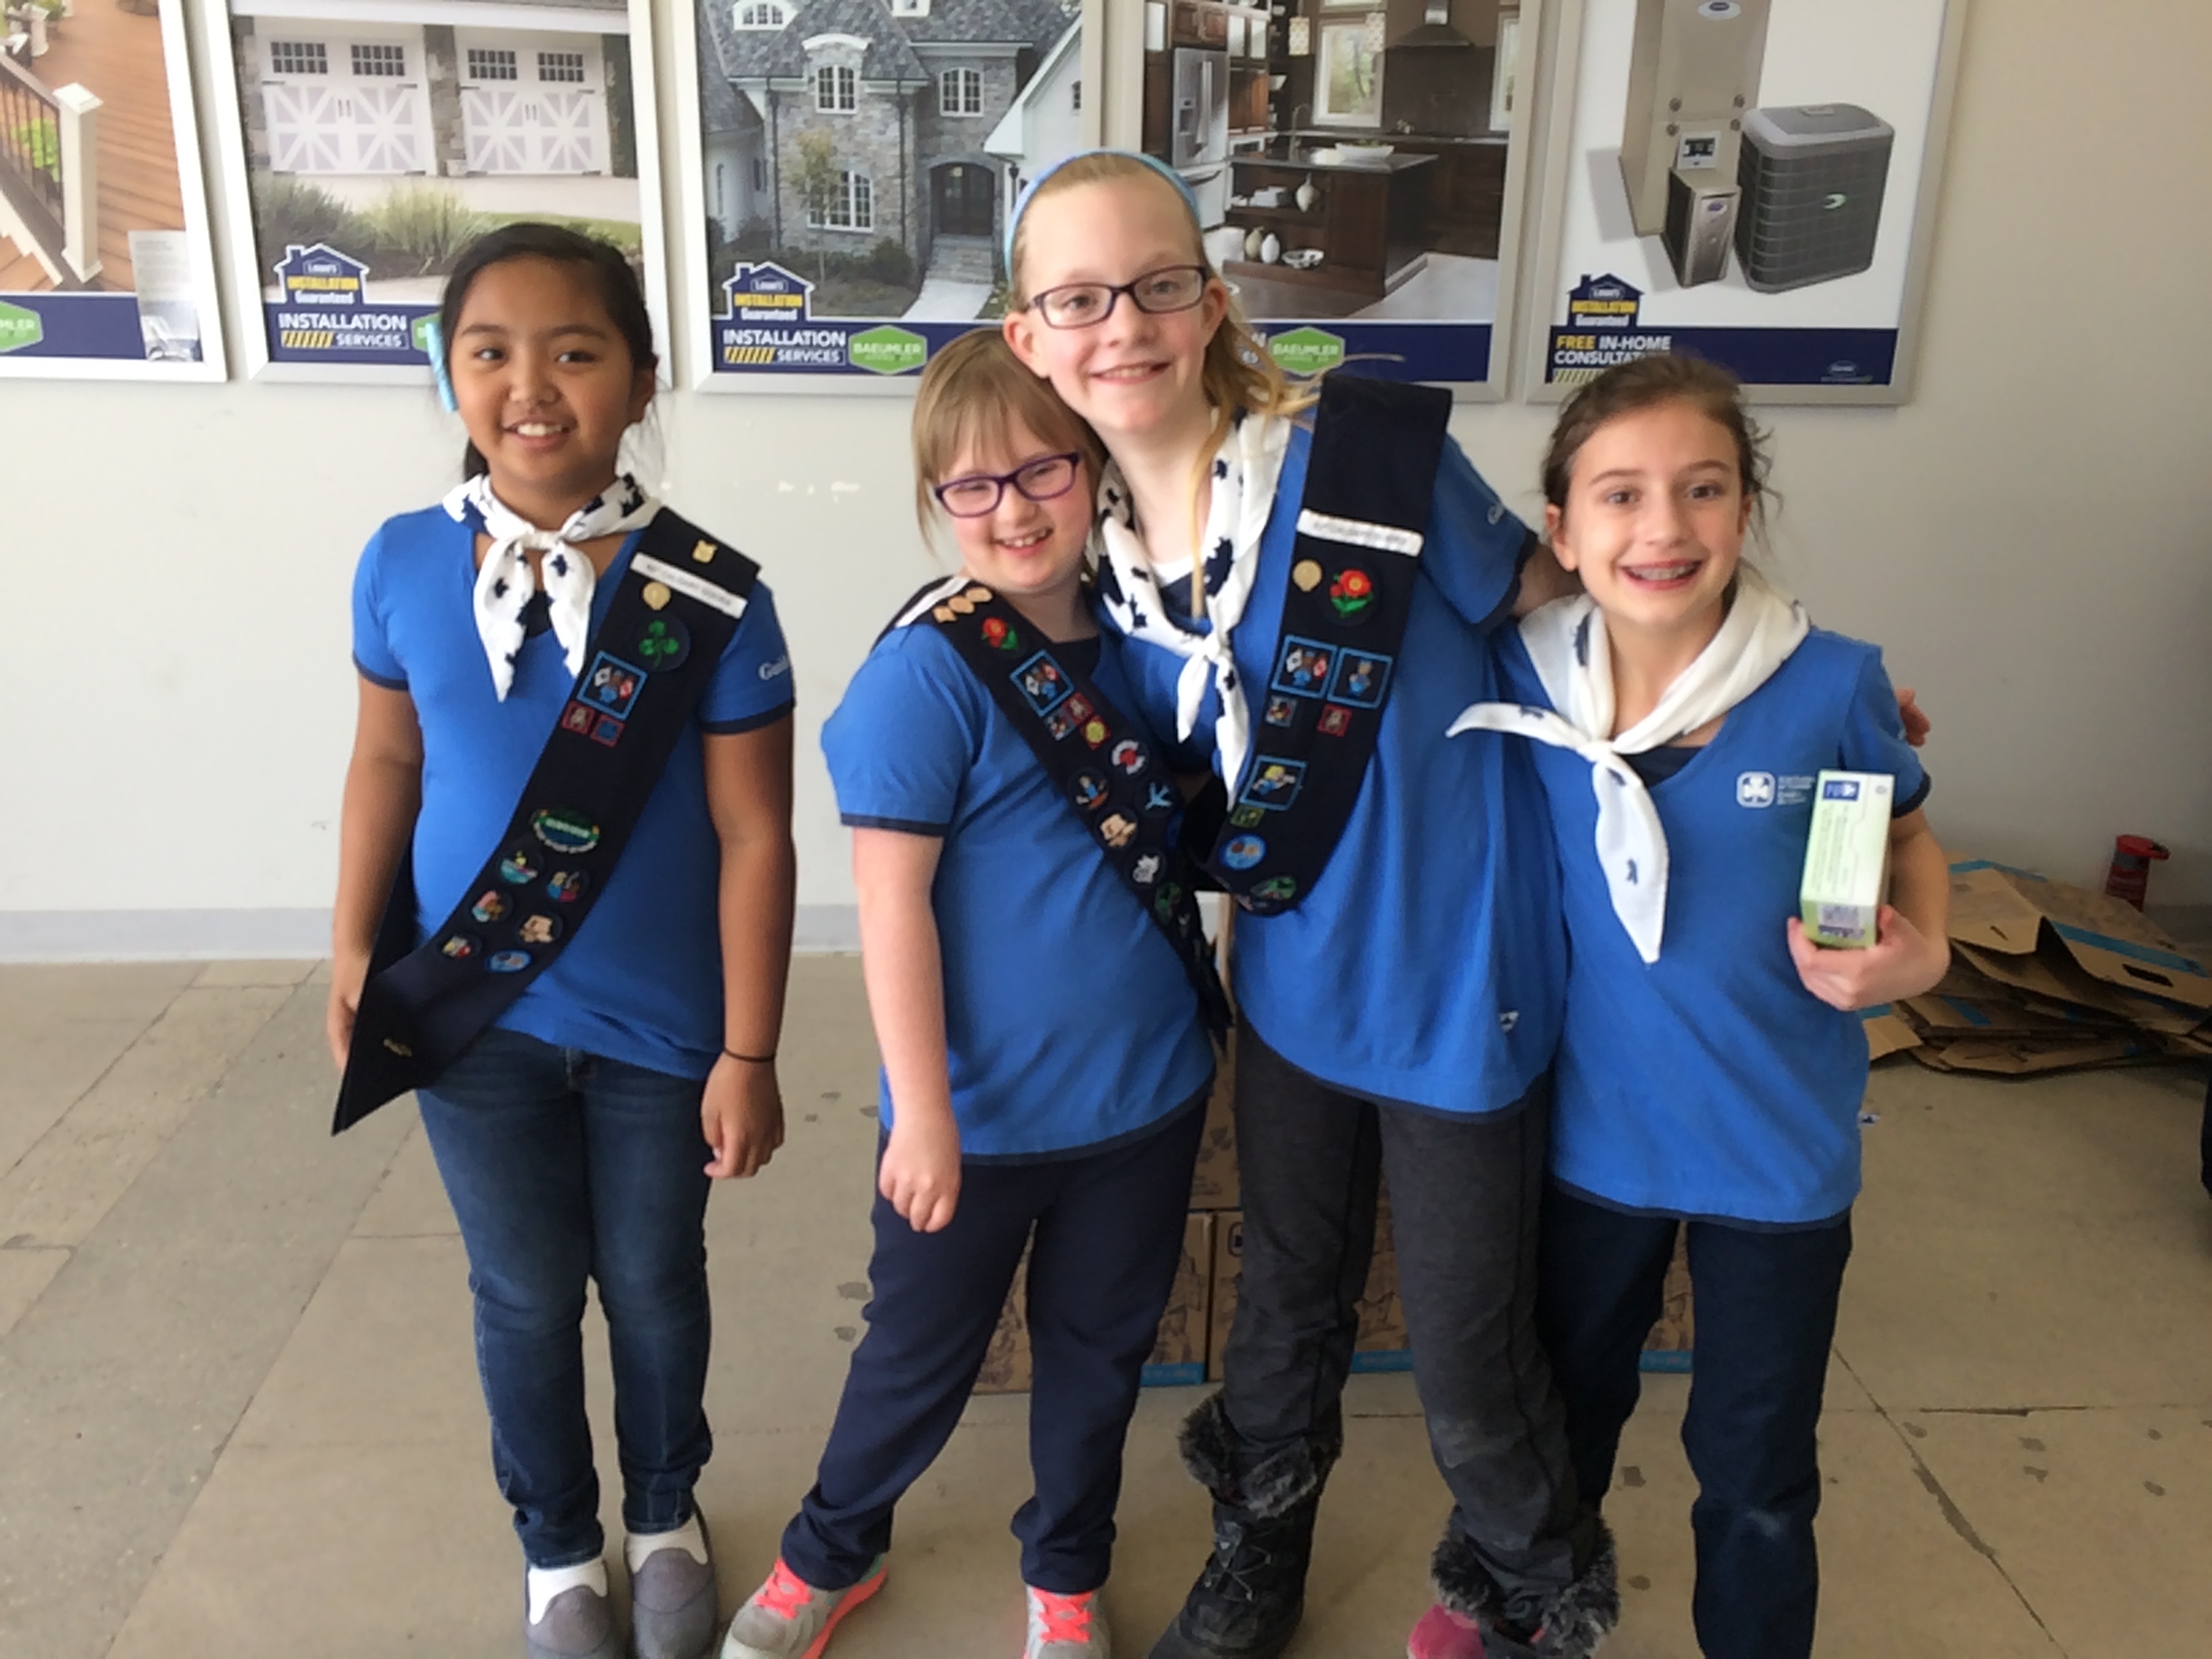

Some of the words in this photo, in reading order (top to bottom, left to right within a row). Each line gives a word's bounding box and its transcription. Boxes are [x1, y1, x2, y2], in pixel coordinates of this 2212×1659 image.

[279, 313, 407, 331] INSTALLATION
[336, 333, 402, 347] SERVICES
[723, 329, 846, 347] INSTALLATION
[1555, 334, 1596, 350] FREE
[1599, 335, 1672, 351] IN-HOME
[777, 350, 840, 363] SERVICES
